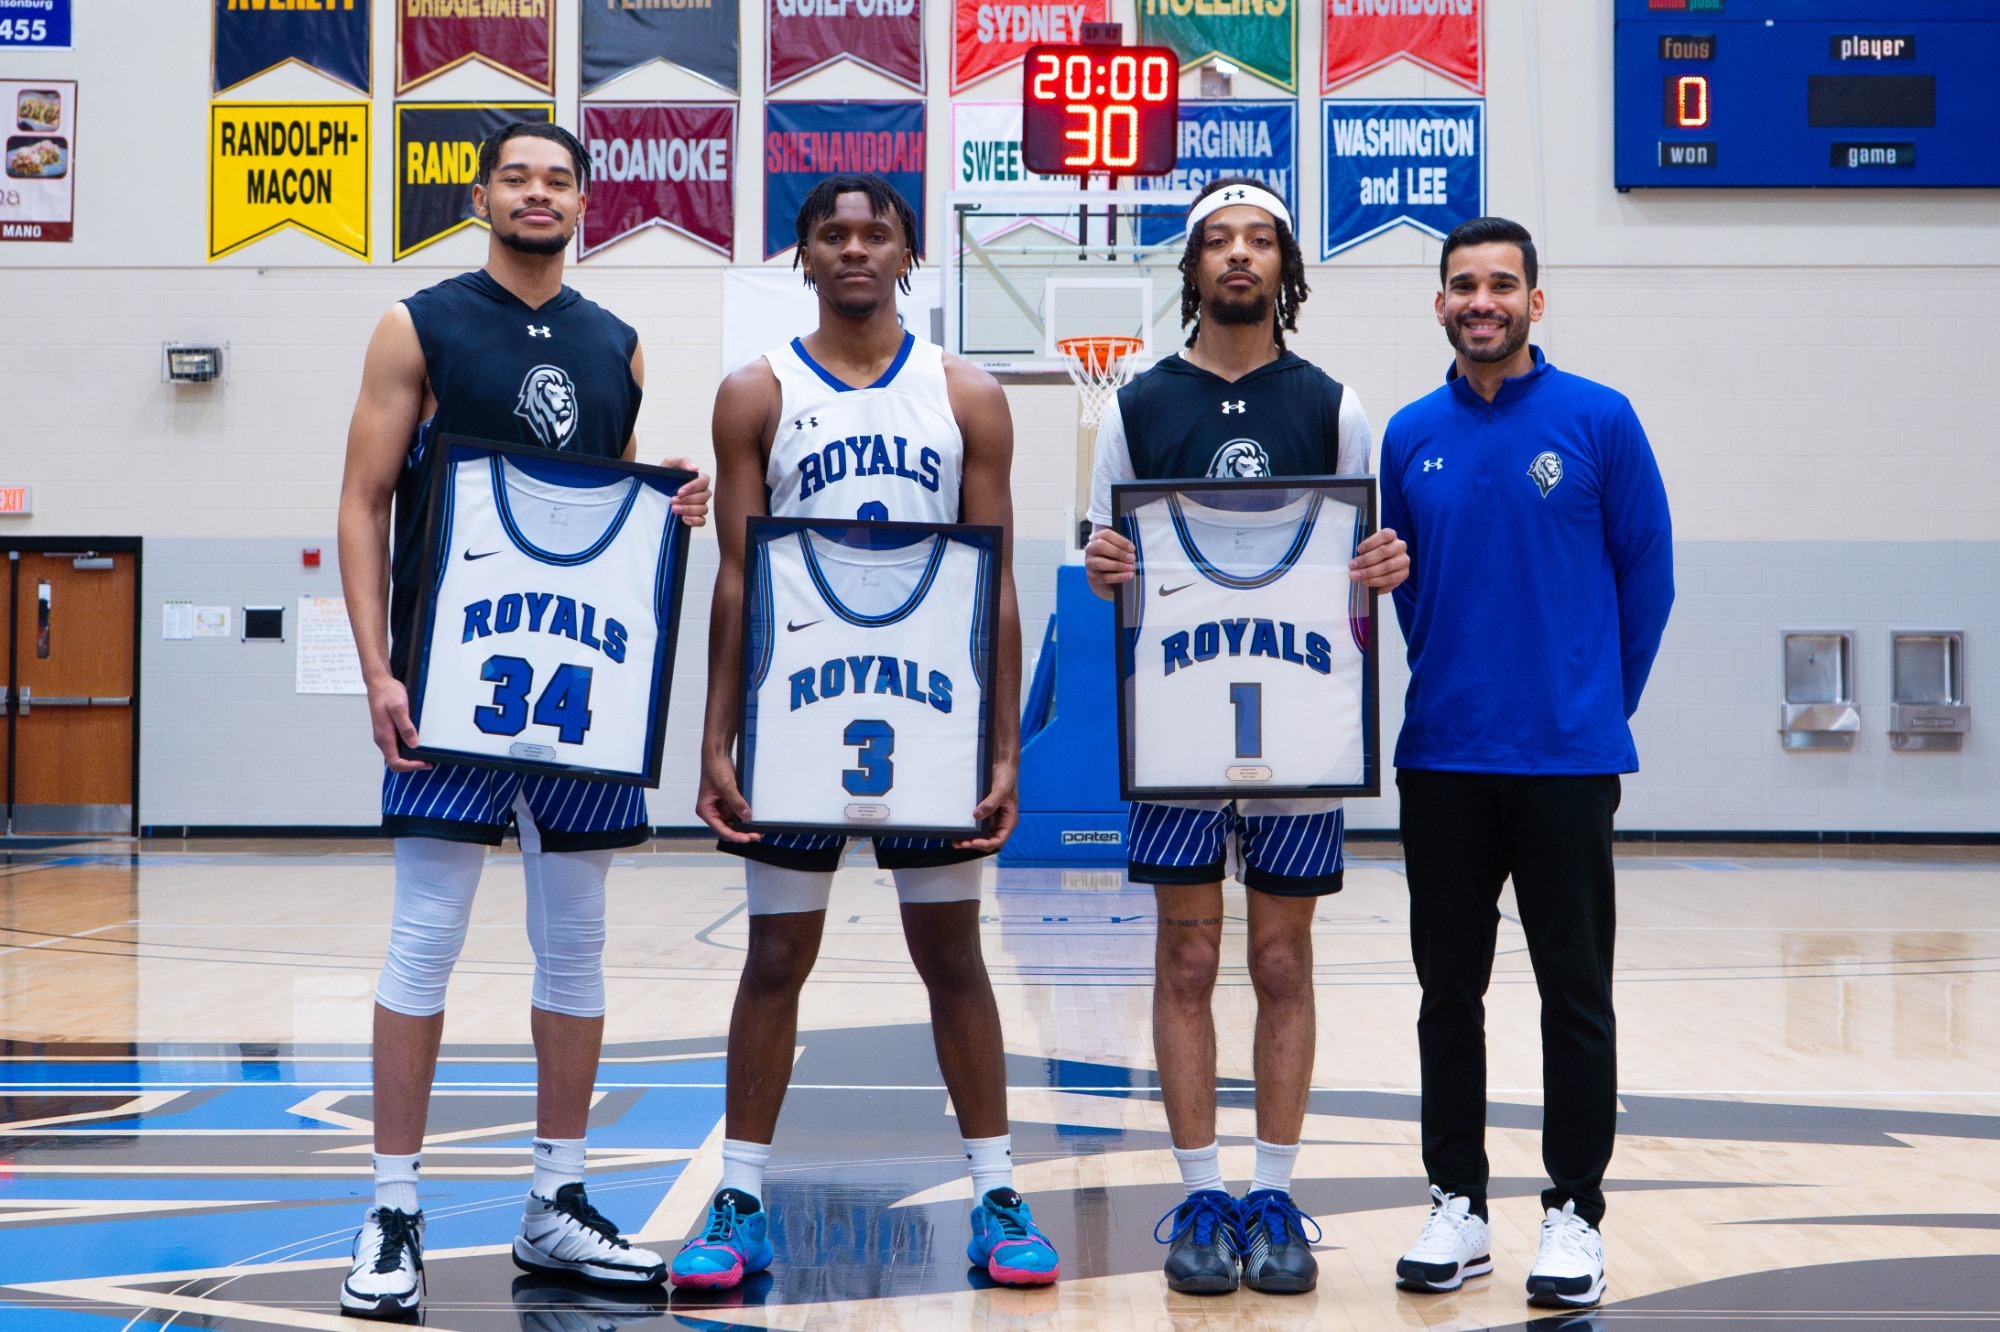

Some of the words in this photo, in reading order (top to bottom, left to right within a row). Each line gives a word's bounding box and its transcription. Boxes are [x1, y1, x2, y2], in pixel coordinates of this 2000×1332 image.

[0, 19, 47, 41] 455
[977, 4, 1085, 43] SYDNEY
[1664, 37, 1710, 59] fouls
[1841, 35, 1905, 60] player
[1034, 55, 1169, 101] 20:00
[1679, 76, 1708, 126] 0
[221, 120, 358, 157] RANDOLPH-
[767, 131, 924, 173] SHENANDOAH
[1064, 104, 1138, 167] 30
[1177, 119, 1273, 159] IRGINIA
[1332, 118, 1475, 157] WASHINGTON
[1670, 145, 1708, 164] won
[406, 141, 486, 185] RAND
[589, 138, 727, 182] ROANOKE
[1847, 146, 1897, 169] game
[247, 168, 332, 204] MACON
[1360, 167, 1399, 205] and
[1407, 167, 1448, 205] LEE
[3, 224, 42, 239] MANO
[798, 434, 942, 501] ROYALS
[0, 487, 25, 511] XIT
[461, 592, 629, 664] ROYALS
[1161, 617, 1332, 677] ROYALS
[473, 654, 594, 746] 34
[788, 655, 953, 714] ROYALS
[1230, 682, 1262, 759] 1
[842, 719, 896, 797] 3
[1063, 831, 1120, 844] porter
